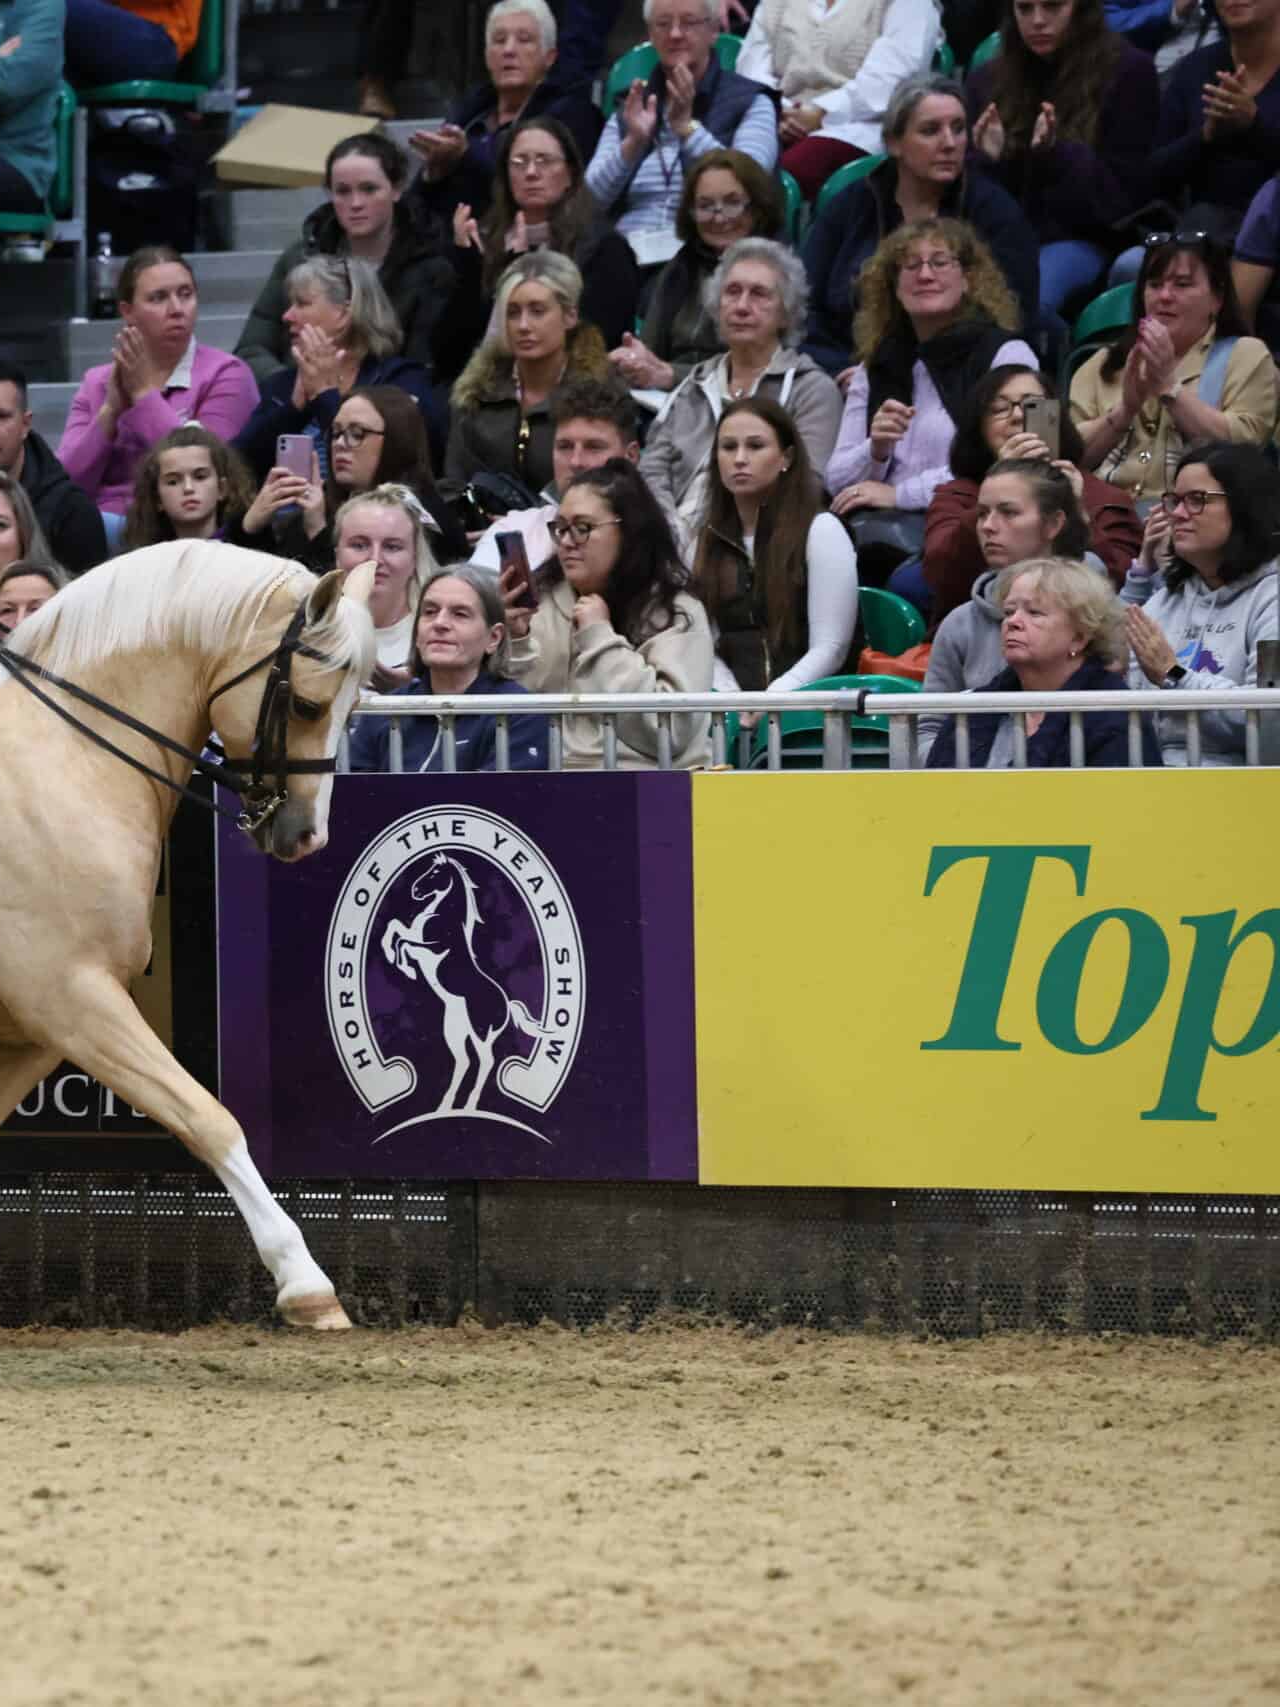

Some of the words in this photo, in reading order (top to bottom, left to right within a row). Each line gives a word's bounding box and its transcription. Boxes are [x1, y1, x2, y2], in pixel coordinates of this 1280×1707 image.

[354, 862, 385, 908] OF
[396, 820, 467, 850] THE
[491, 832, 560, 920] YEAR
[338, 933, 372, 1069] HORSE
[545, 947, 573, 1065] SHOW
[920, 845, 1280, 1122] Top
